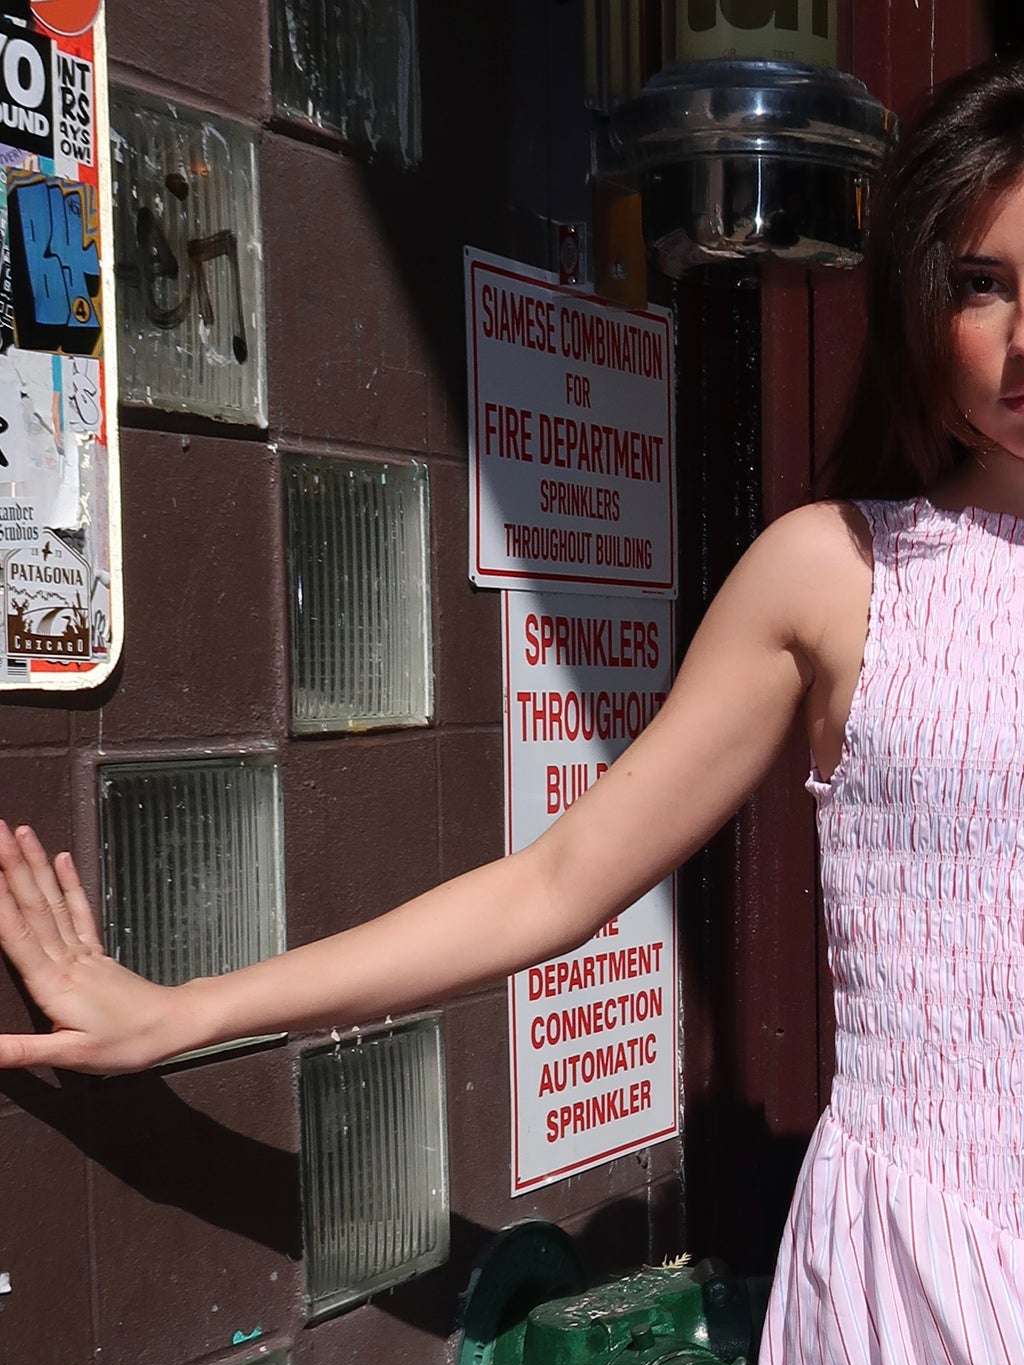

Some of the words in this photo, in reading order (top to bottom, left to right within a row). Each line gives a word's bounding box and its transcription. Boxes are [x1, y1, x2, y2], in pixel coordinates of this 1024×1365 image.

[482, 284, 556, 354] SIAMESE
[560, 307, 663, 380] COMBINATION
[566, 373, 591, 408] FOR
[485, 403, 532, 463] FIRE
[539, 414, 663, 483] DEPARTMENT
[540, 480, 620, 522] SPRINKLERS
[11, 563, 83, 586] PATAGONIA
[504, 523, 593, 565] THROUGHOUT
[595, 533, 652, 570] BUILDING
[14, 634, 84, 653] CHICAGO
[525, 613, 659, 669] SPRINKLERS
[529, 942, 663, 1001] DEPARTMENT
[531, 987, 663, 1049] CONNECTION
[538, 1033, 657, 1097] AUTOMATIC
[547, 1079, 651, 1143] SPRINKLER
